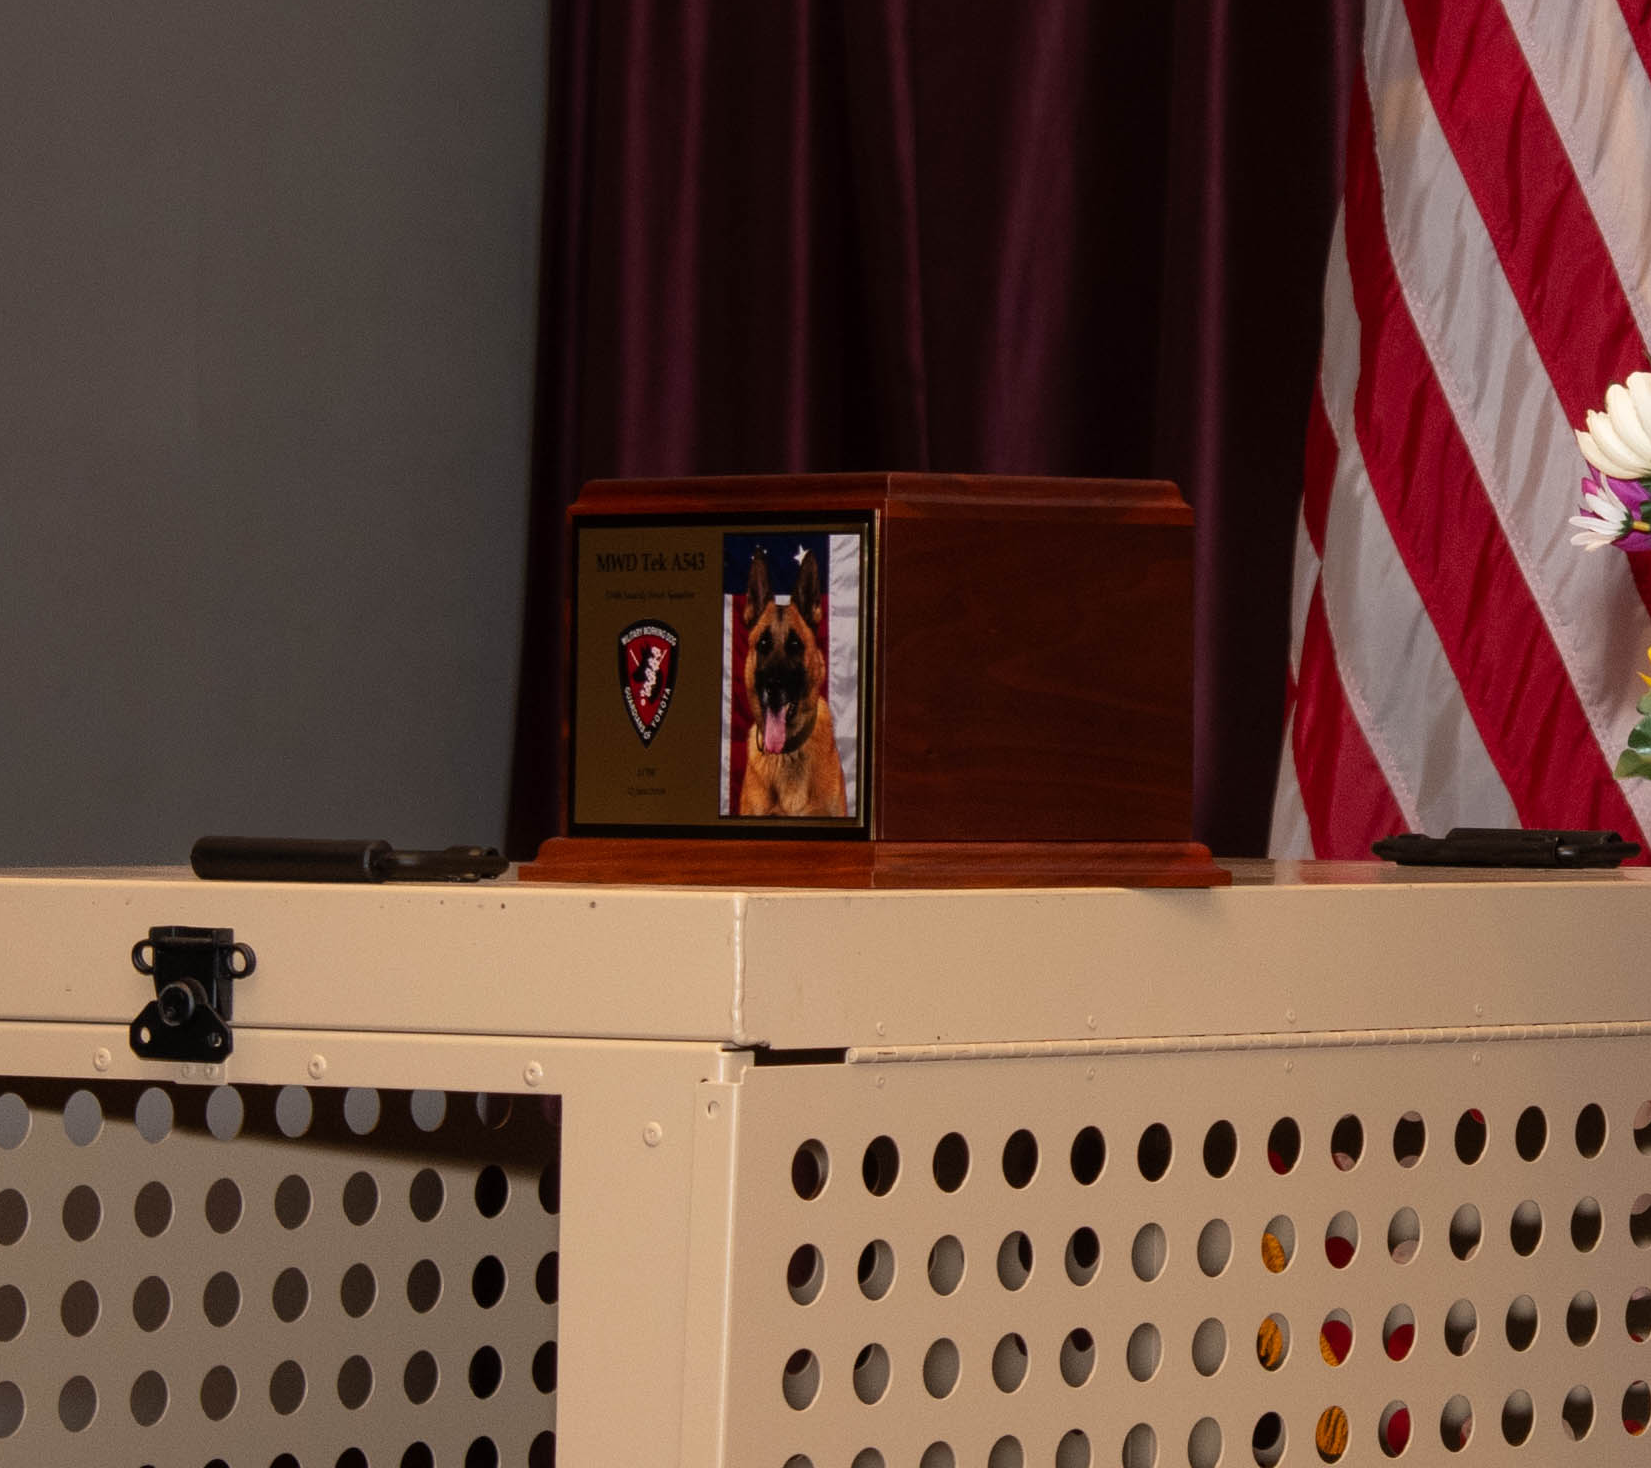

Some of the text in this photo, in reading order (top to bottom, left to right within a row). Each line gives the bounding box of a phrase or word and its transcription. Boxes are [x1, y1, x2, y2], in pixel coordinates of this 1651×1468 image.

[596, 551, 706, 573] MWD Tek A543
[650, 688, 672, 728] YOKOTA
